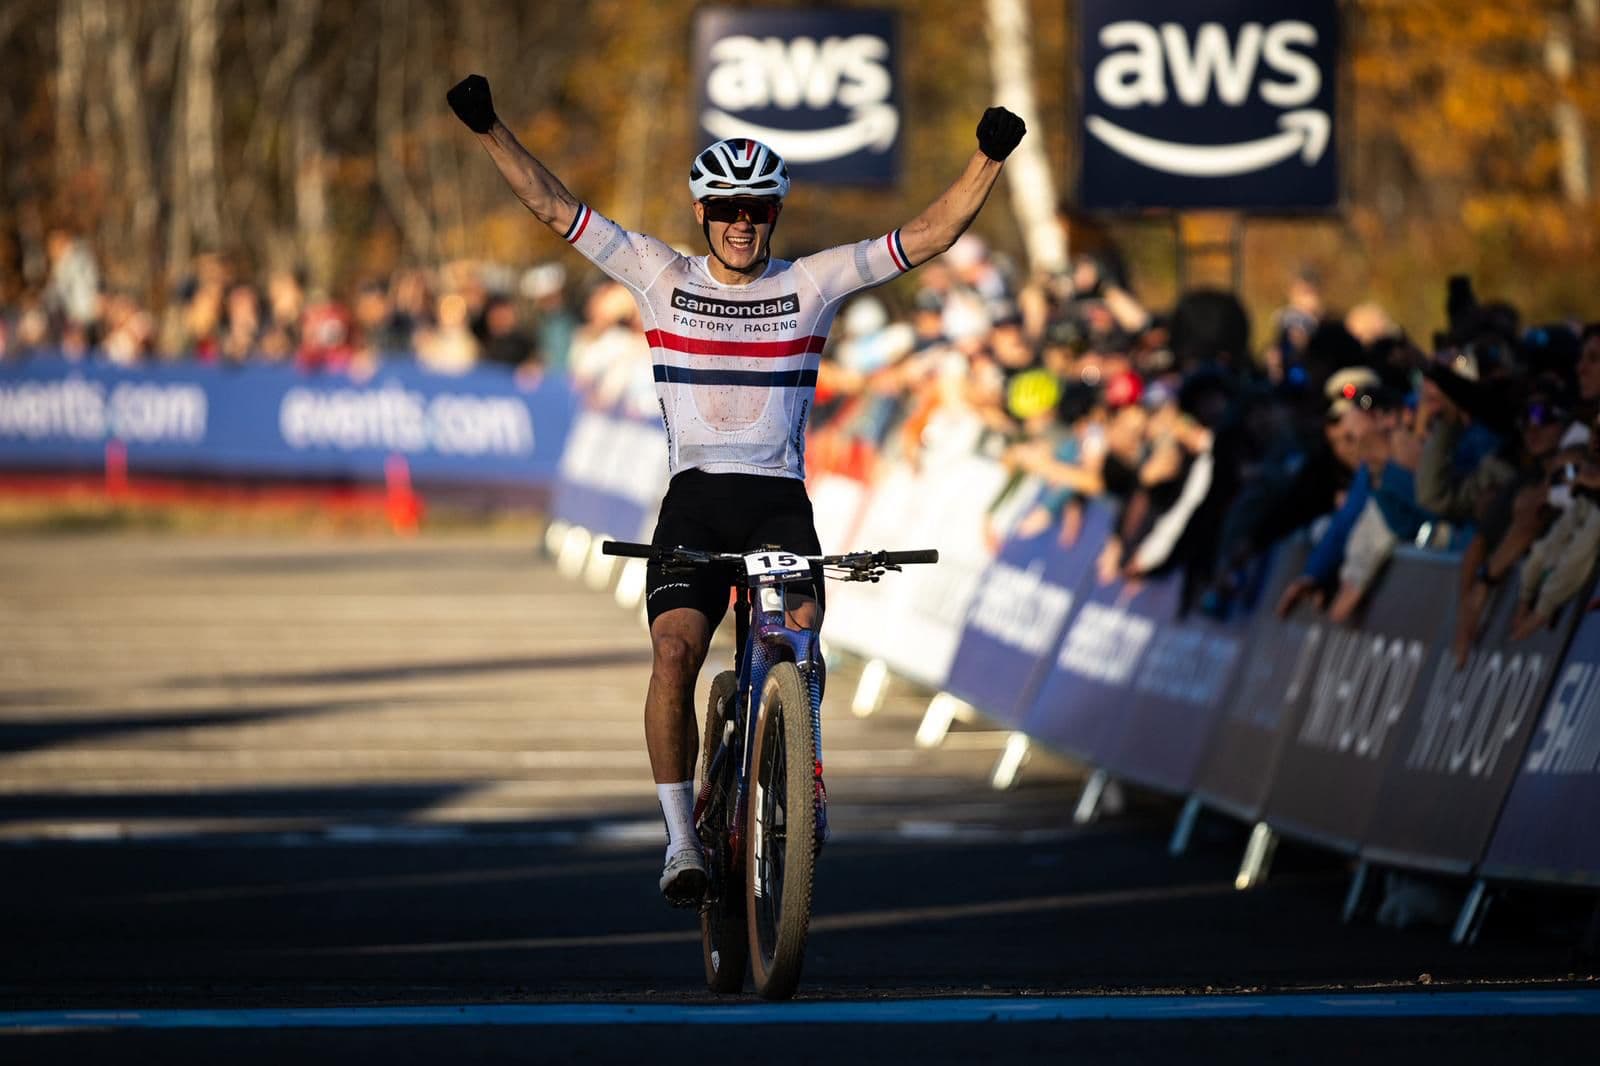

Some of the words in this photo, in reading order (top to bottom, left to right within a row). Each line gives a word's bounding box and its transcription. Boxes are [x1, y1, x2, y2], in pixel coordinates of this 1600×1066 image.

[707, 34, 892, 108] aws
[1096, 21, 1322, 106] aws
[675, 295, 794, 316] cannondale
[673, 315, 734, 332] FACTORY
[744, 319, 798, 332] RACING
[757, 555, 798, 568] 15
